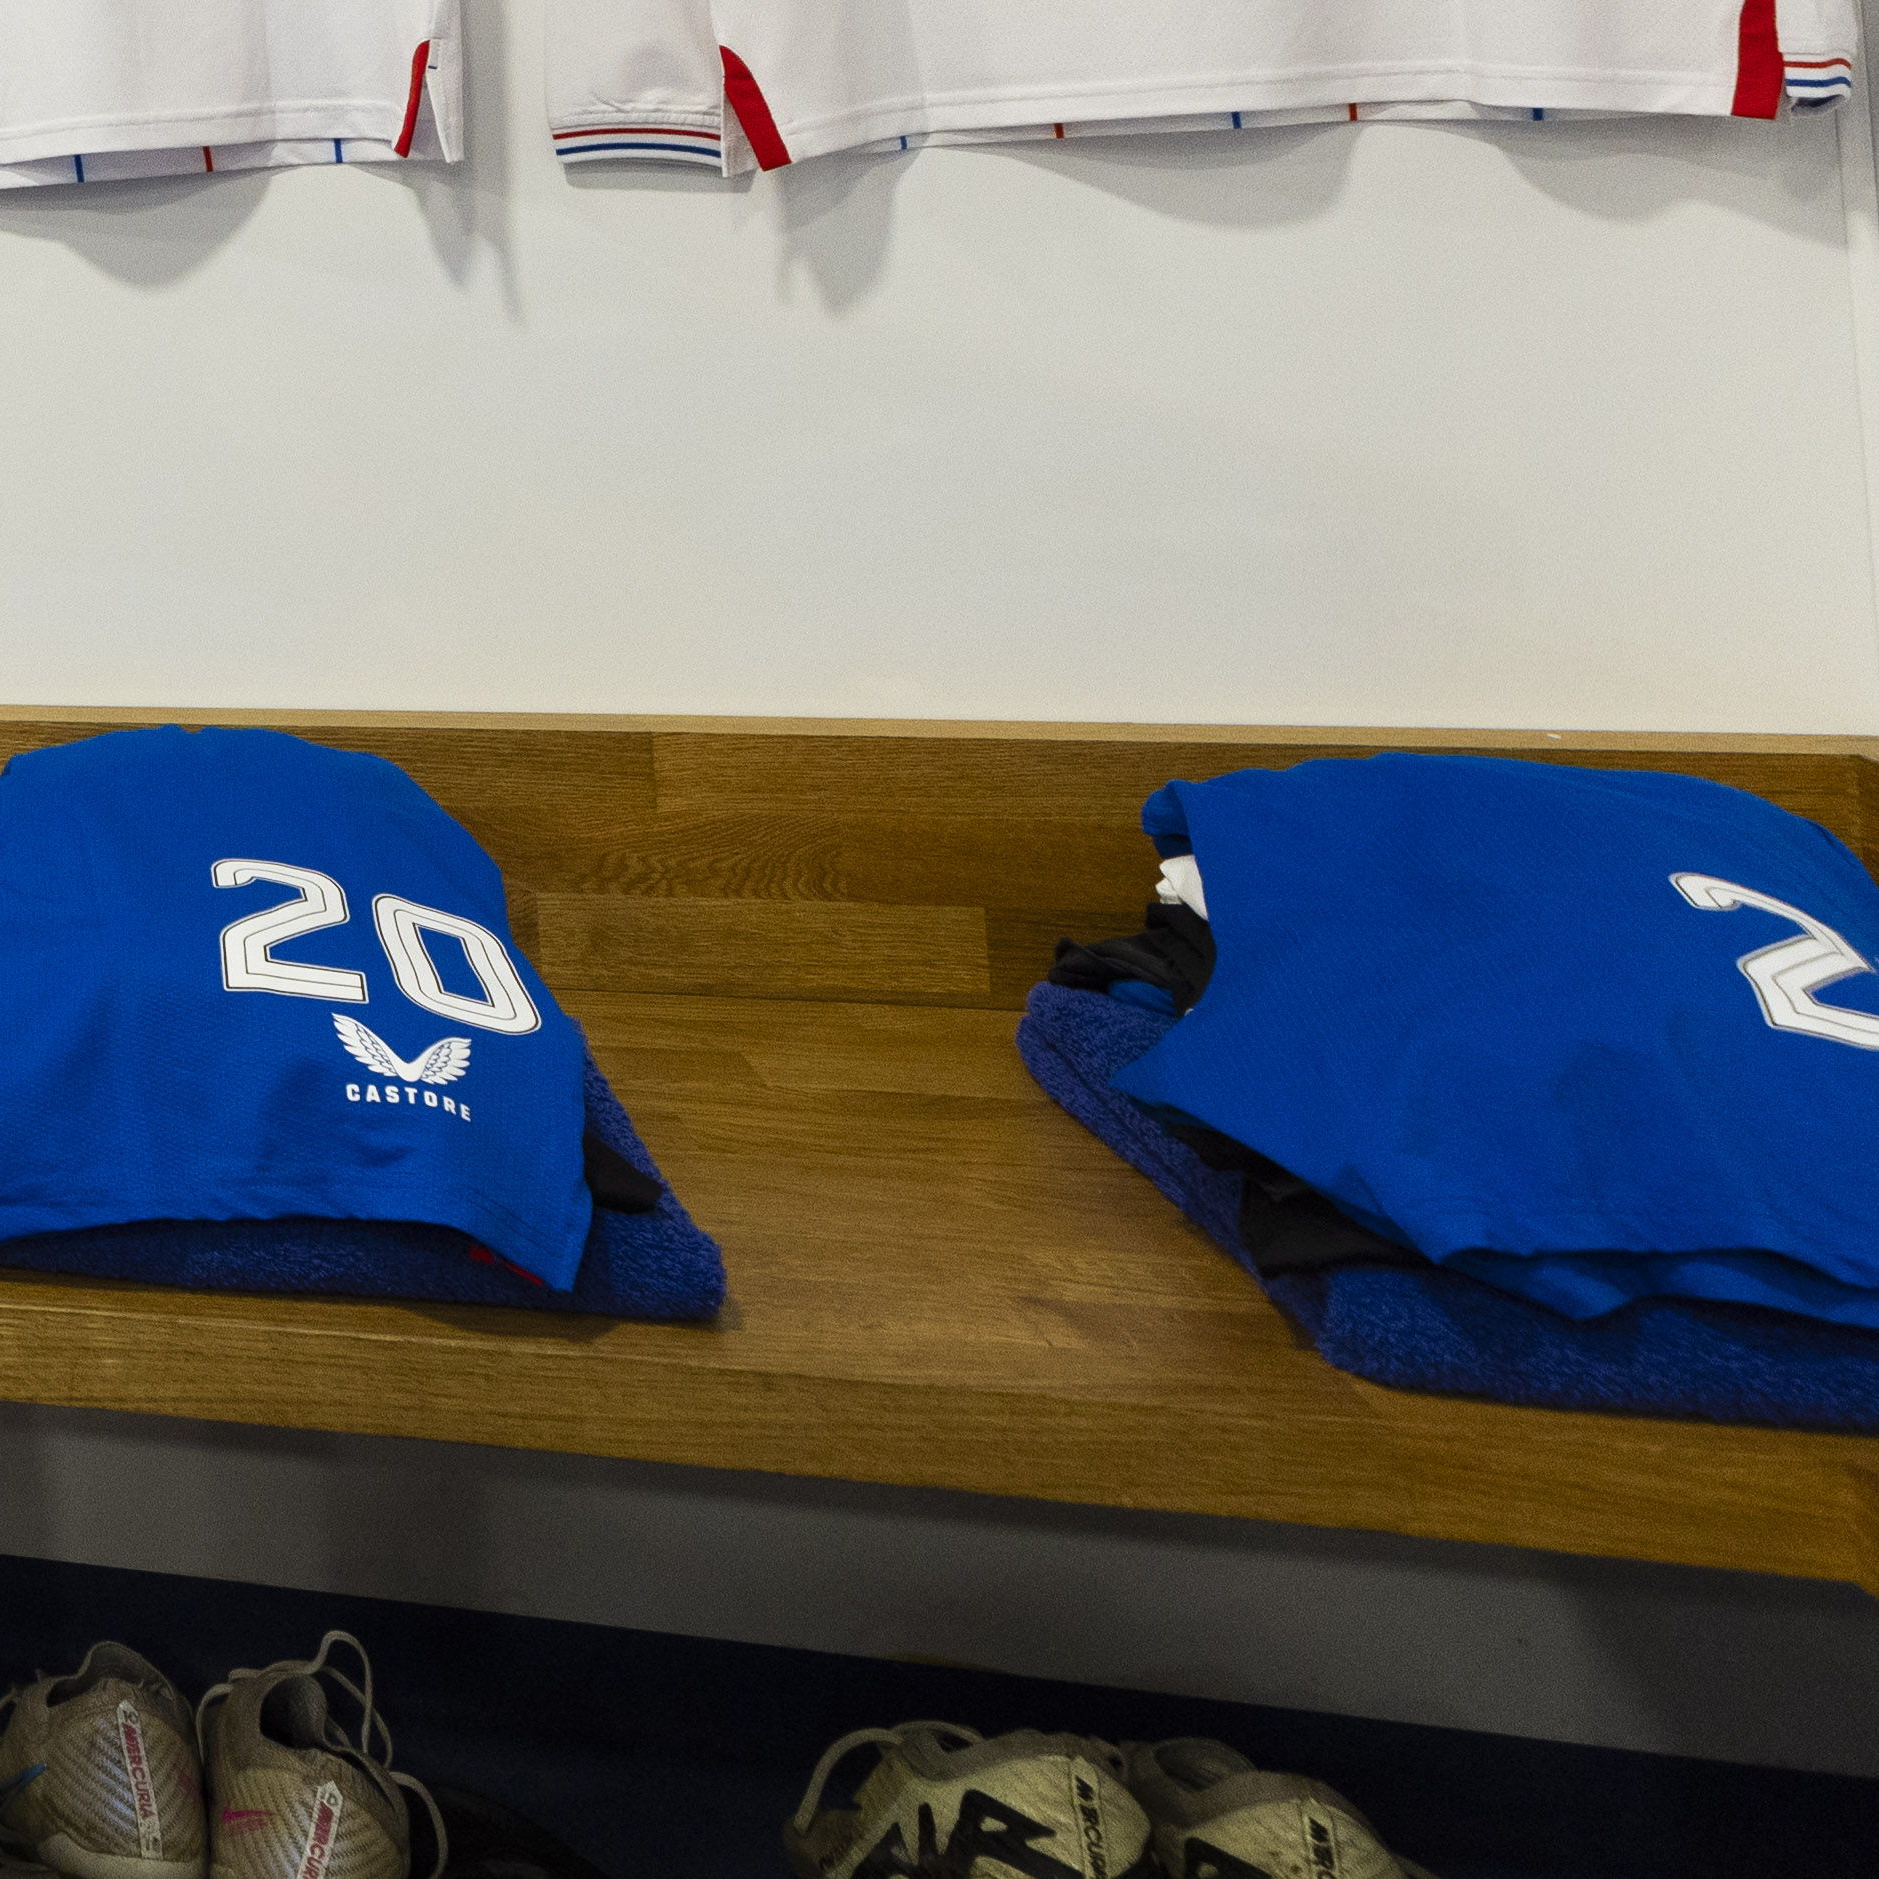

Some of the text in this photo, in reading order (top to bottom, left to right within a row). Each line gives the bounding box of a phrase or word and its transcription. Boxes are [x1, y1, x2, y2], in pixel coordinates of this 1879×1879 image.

[210, 858, 543, 1036] 20
[1668, 871, 1879, 1050] 2
[346, 1083, 472, 1123] CASTORE
[122, 1722, 154, 1821] MERCURIA
